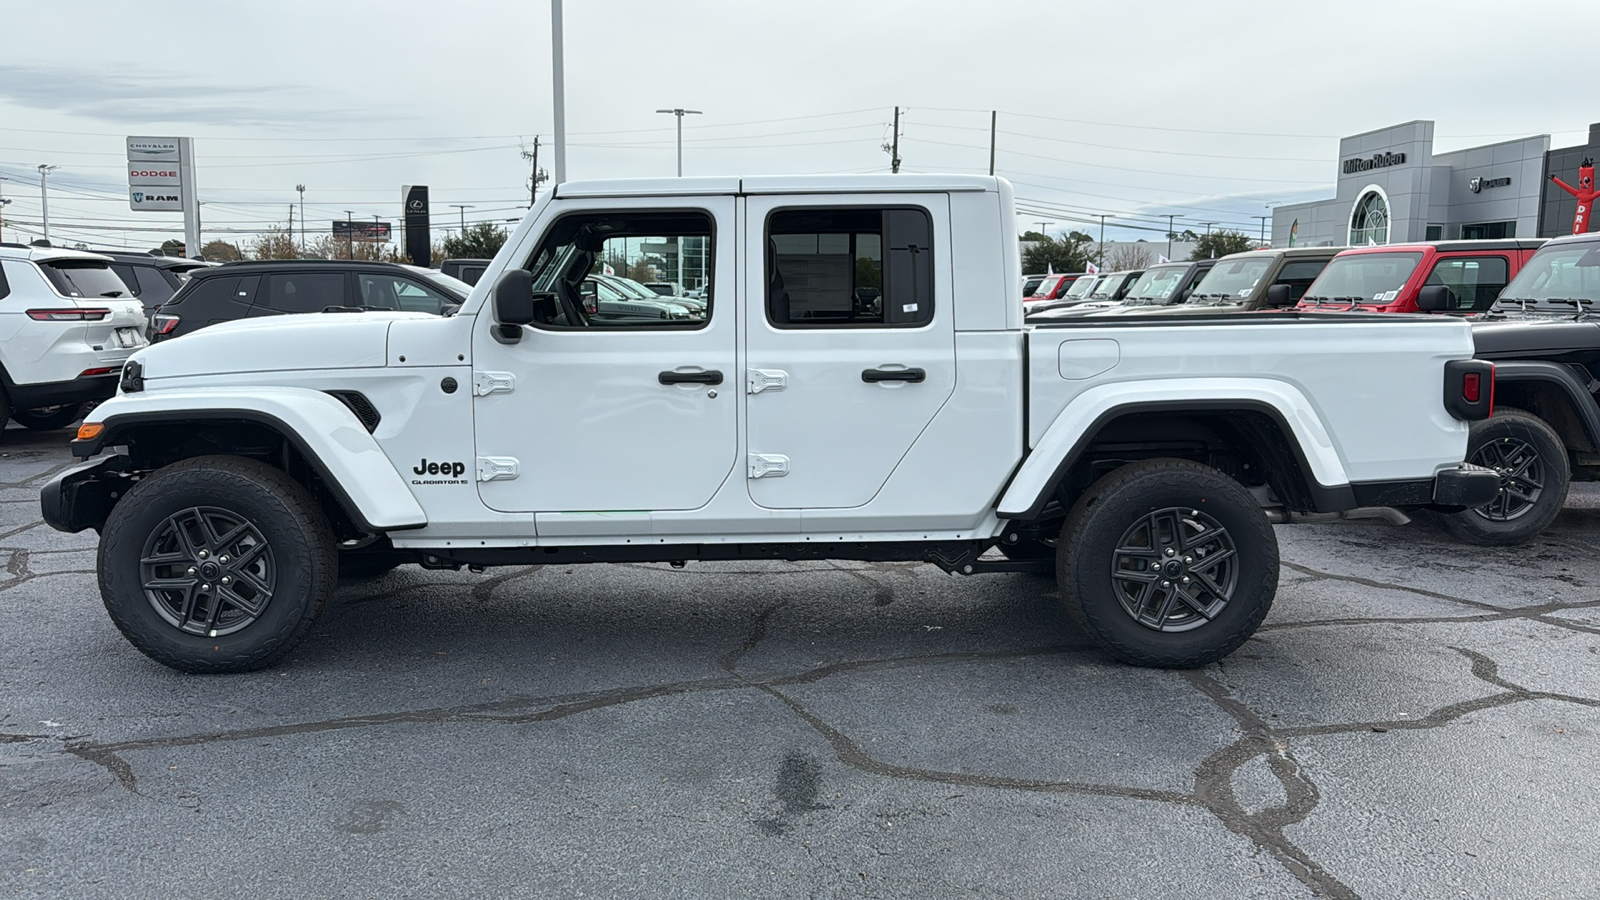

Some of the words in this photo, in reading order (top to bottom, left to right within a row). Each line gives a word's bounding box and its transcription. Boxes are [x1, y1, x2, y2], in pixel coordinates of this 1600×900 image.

[1343, 157, 1373, 174] Milton
[1373, 151, 1407, 169] Ruben
[413, 458, 465, 478] Jeep
